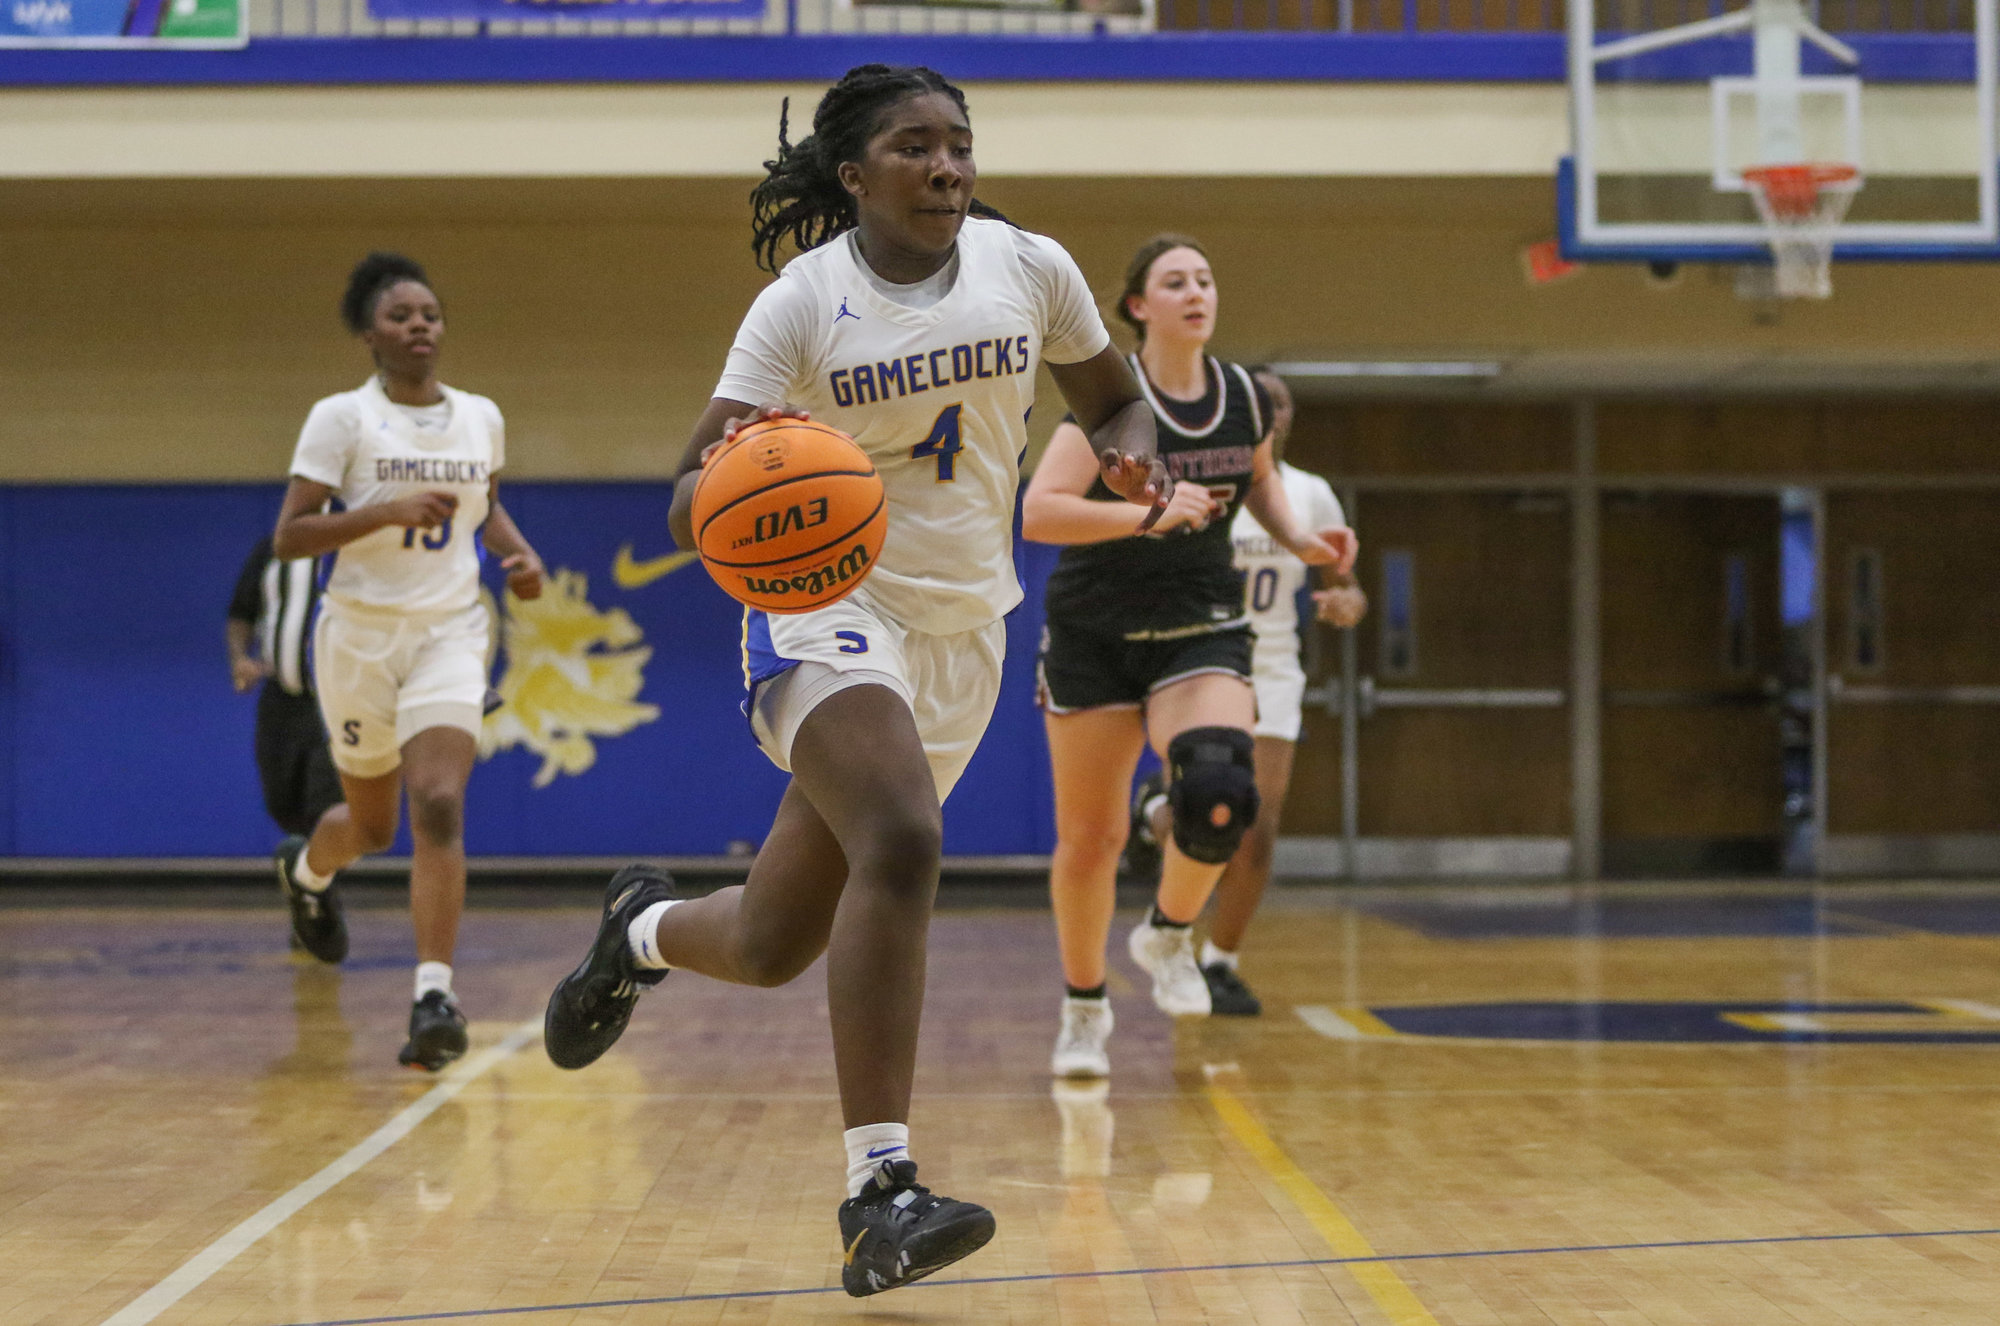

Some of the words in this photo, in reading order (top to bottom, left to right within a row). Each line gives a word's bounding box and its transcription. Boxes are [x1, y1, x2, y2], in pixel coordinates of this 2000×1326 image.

[830, 335, 1029, 408] GAMECOCKS
[910, 401, 964, 483] 4
[376, 458, 489, 482] GAMECOCKS
[755, 497, 828, 543] EVO
[731, 536, 754, 551] NXT
[743, 543, 870, 595] Wilson
[343, 719, 361, 746] S
